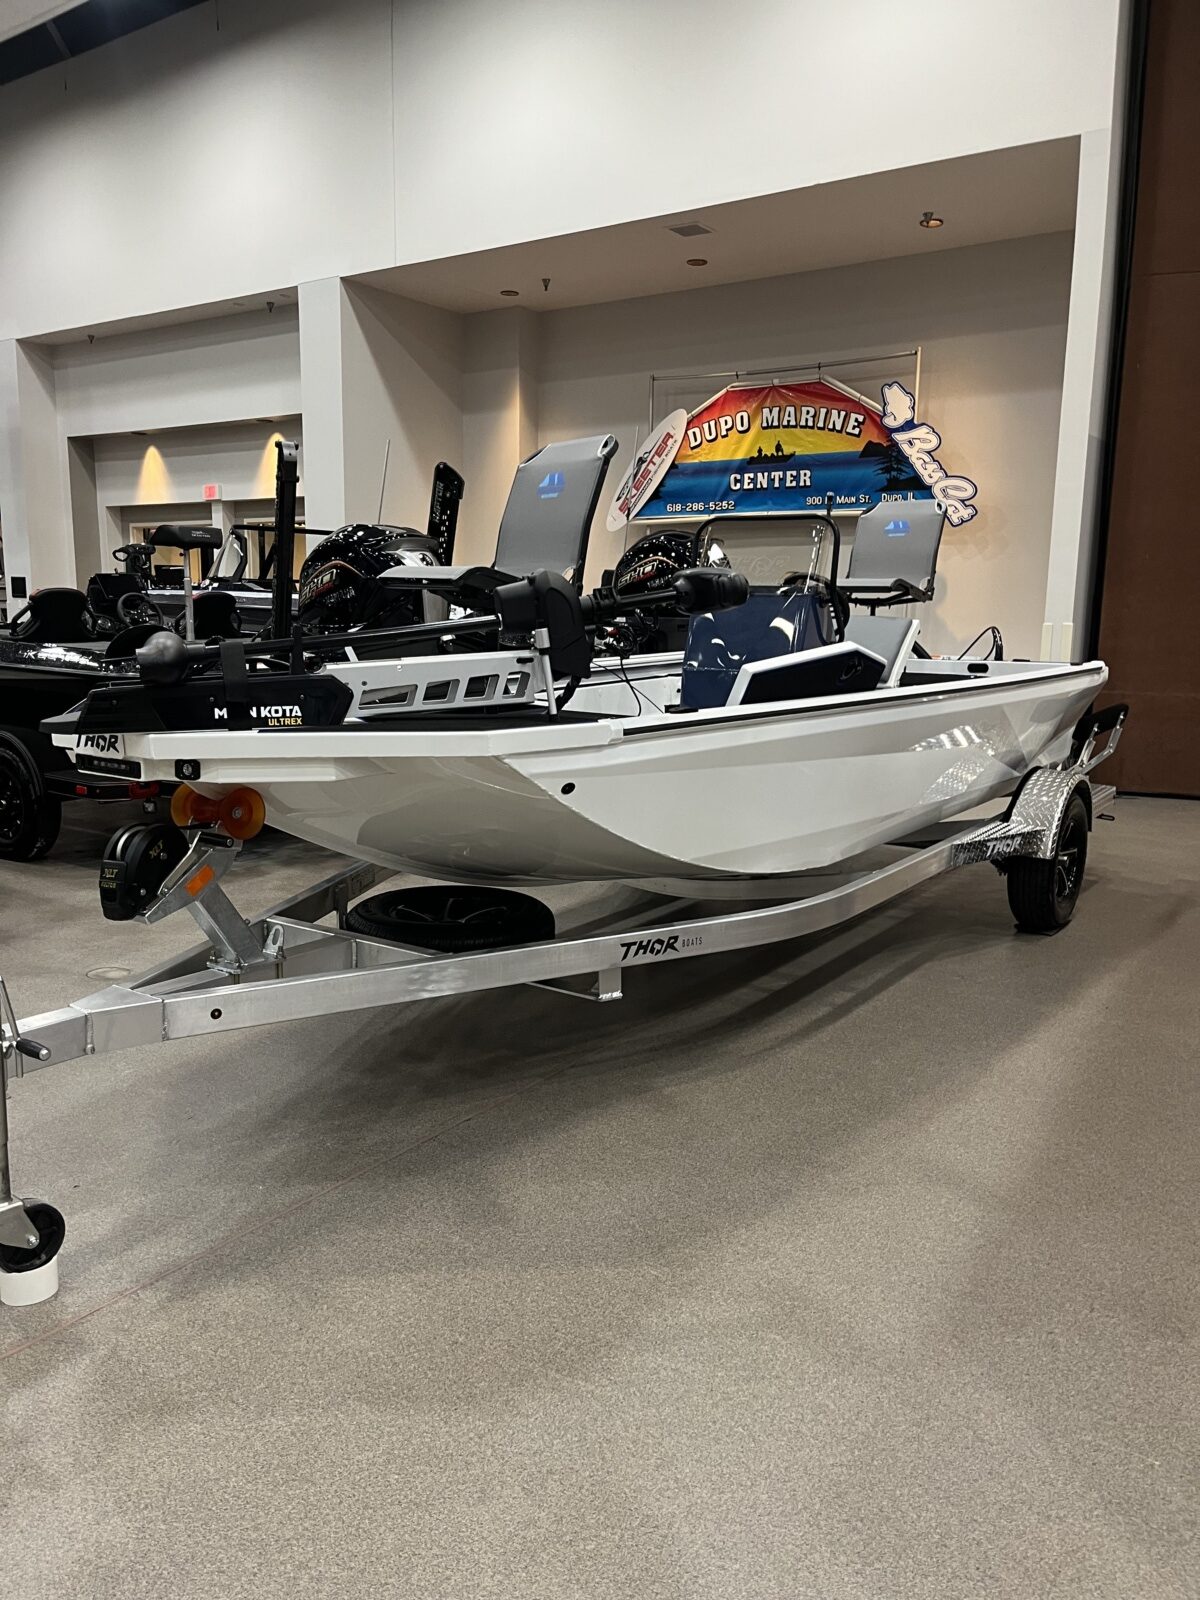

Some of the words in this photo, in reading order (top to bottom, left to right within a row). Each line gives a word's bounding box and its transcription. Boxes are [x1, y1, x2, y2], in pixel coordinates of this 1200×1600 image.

[687, 411, 751, 450] DUPO
[761, 406, 866, 437] MARINE
[619, 432, 674, 514] SKEETER
[730, 469, 813, 491] CENTER
[806, 496, 823, 506] 900
[907, 493, 917, 501] IL
[666, 500, 735, 513] 618-286-5252
[214, 707, 258, 719] MN
[261, 706, 302, 718] KOTA
[268, 717, 303, 727] ULTREX
[985, 836, 1023, 858] THOR
[620, 935, 680, 962] THOR
[682, 936, 703, 948] BOATS
